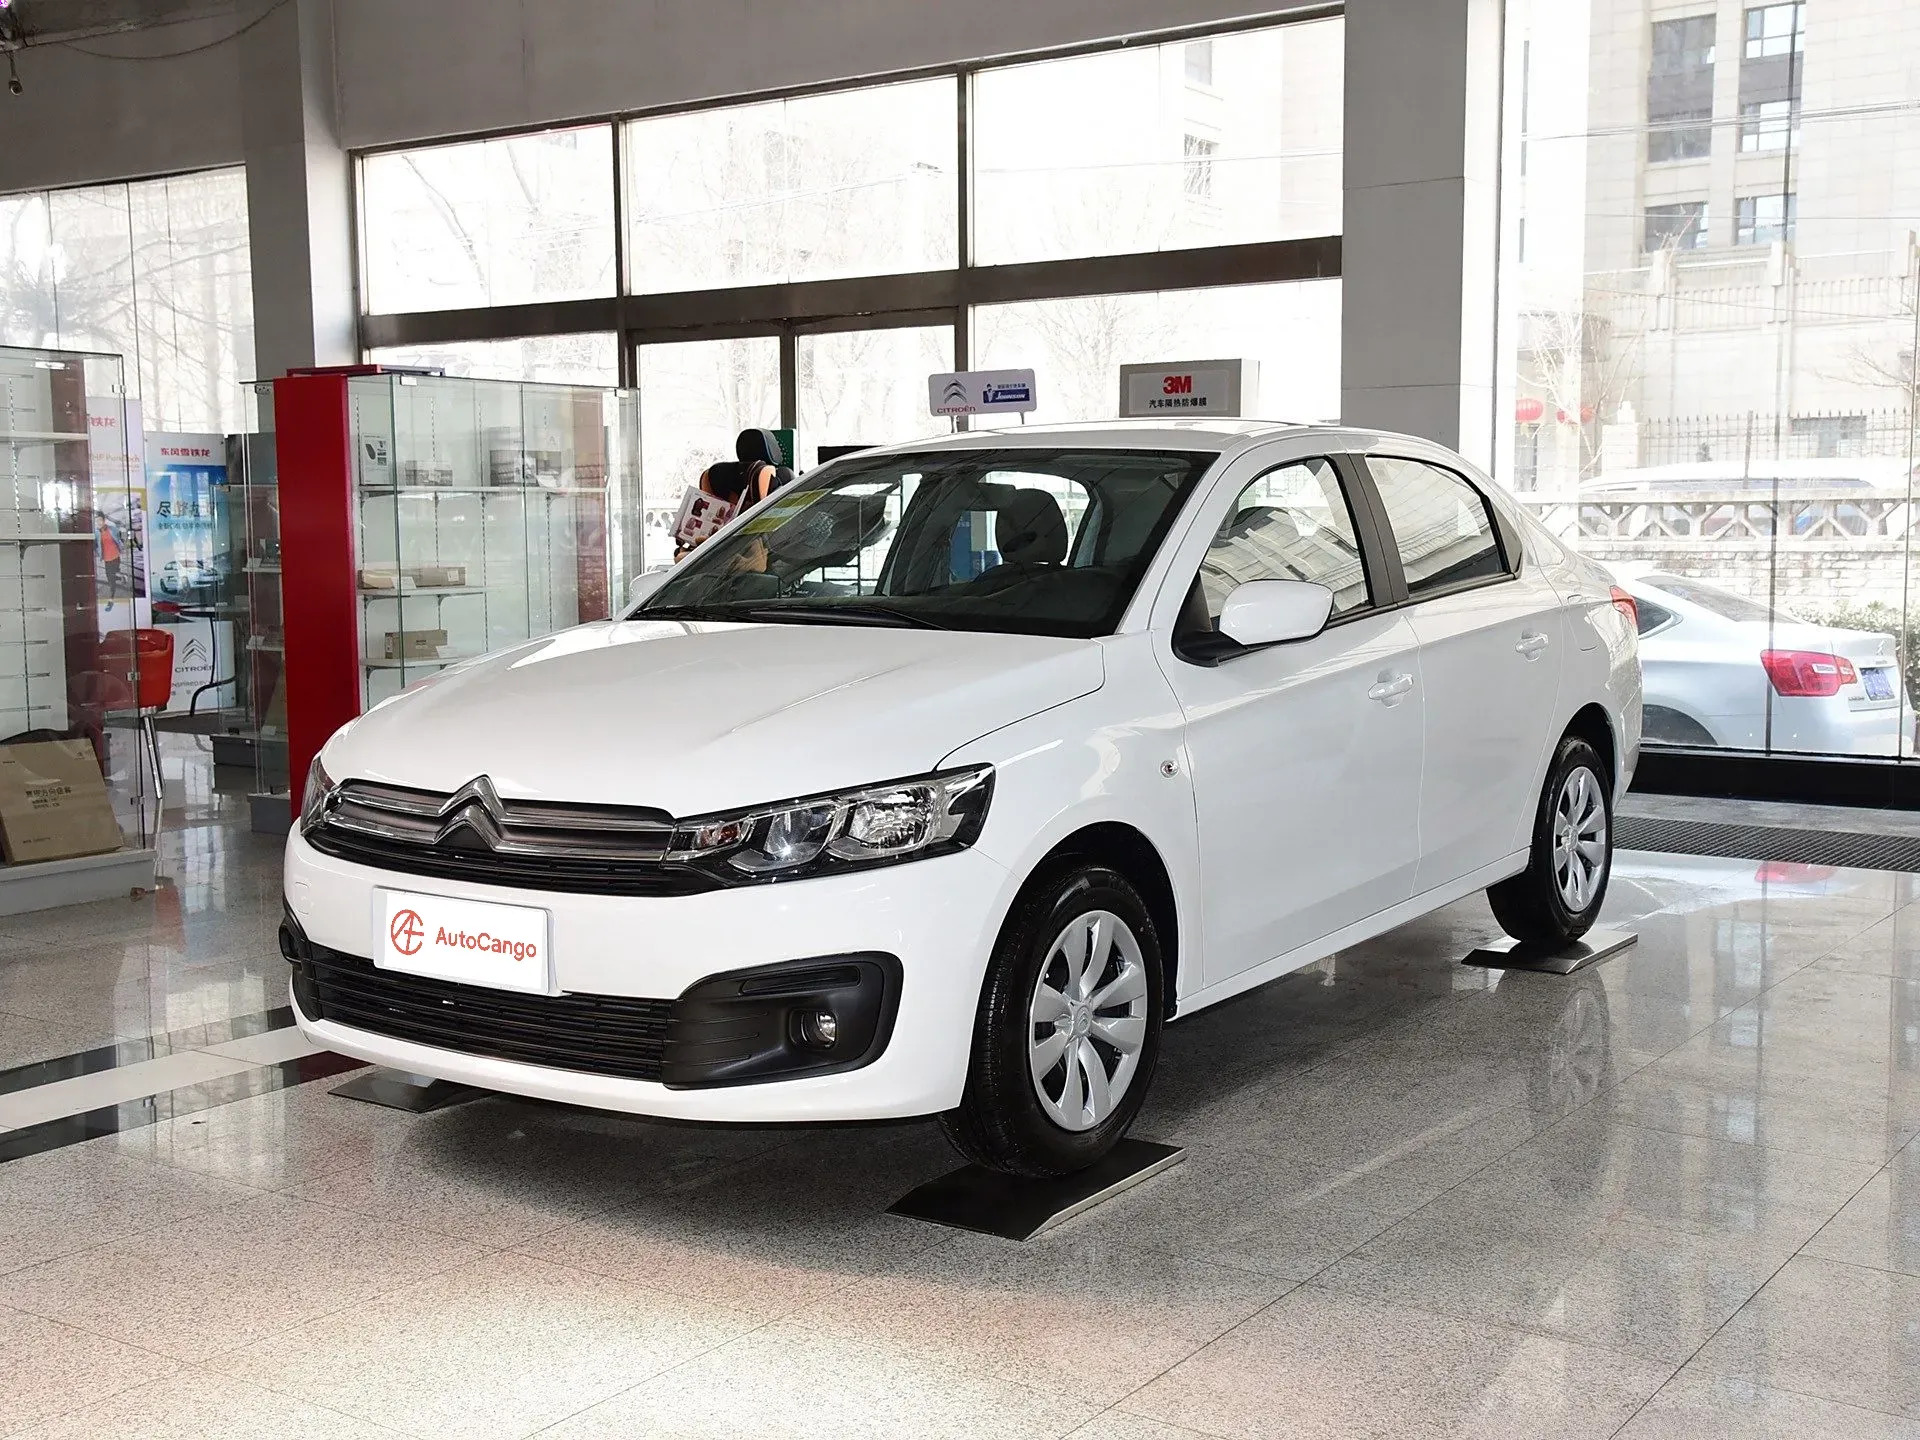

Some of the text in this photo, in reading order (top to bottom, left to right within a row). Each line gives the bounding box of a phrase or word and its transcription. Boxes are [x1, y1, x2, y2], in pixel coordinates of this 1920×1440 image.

[1163, 375, 1192, 394] 3M
[160, 447, 211, 457] 东风雪铁龙
